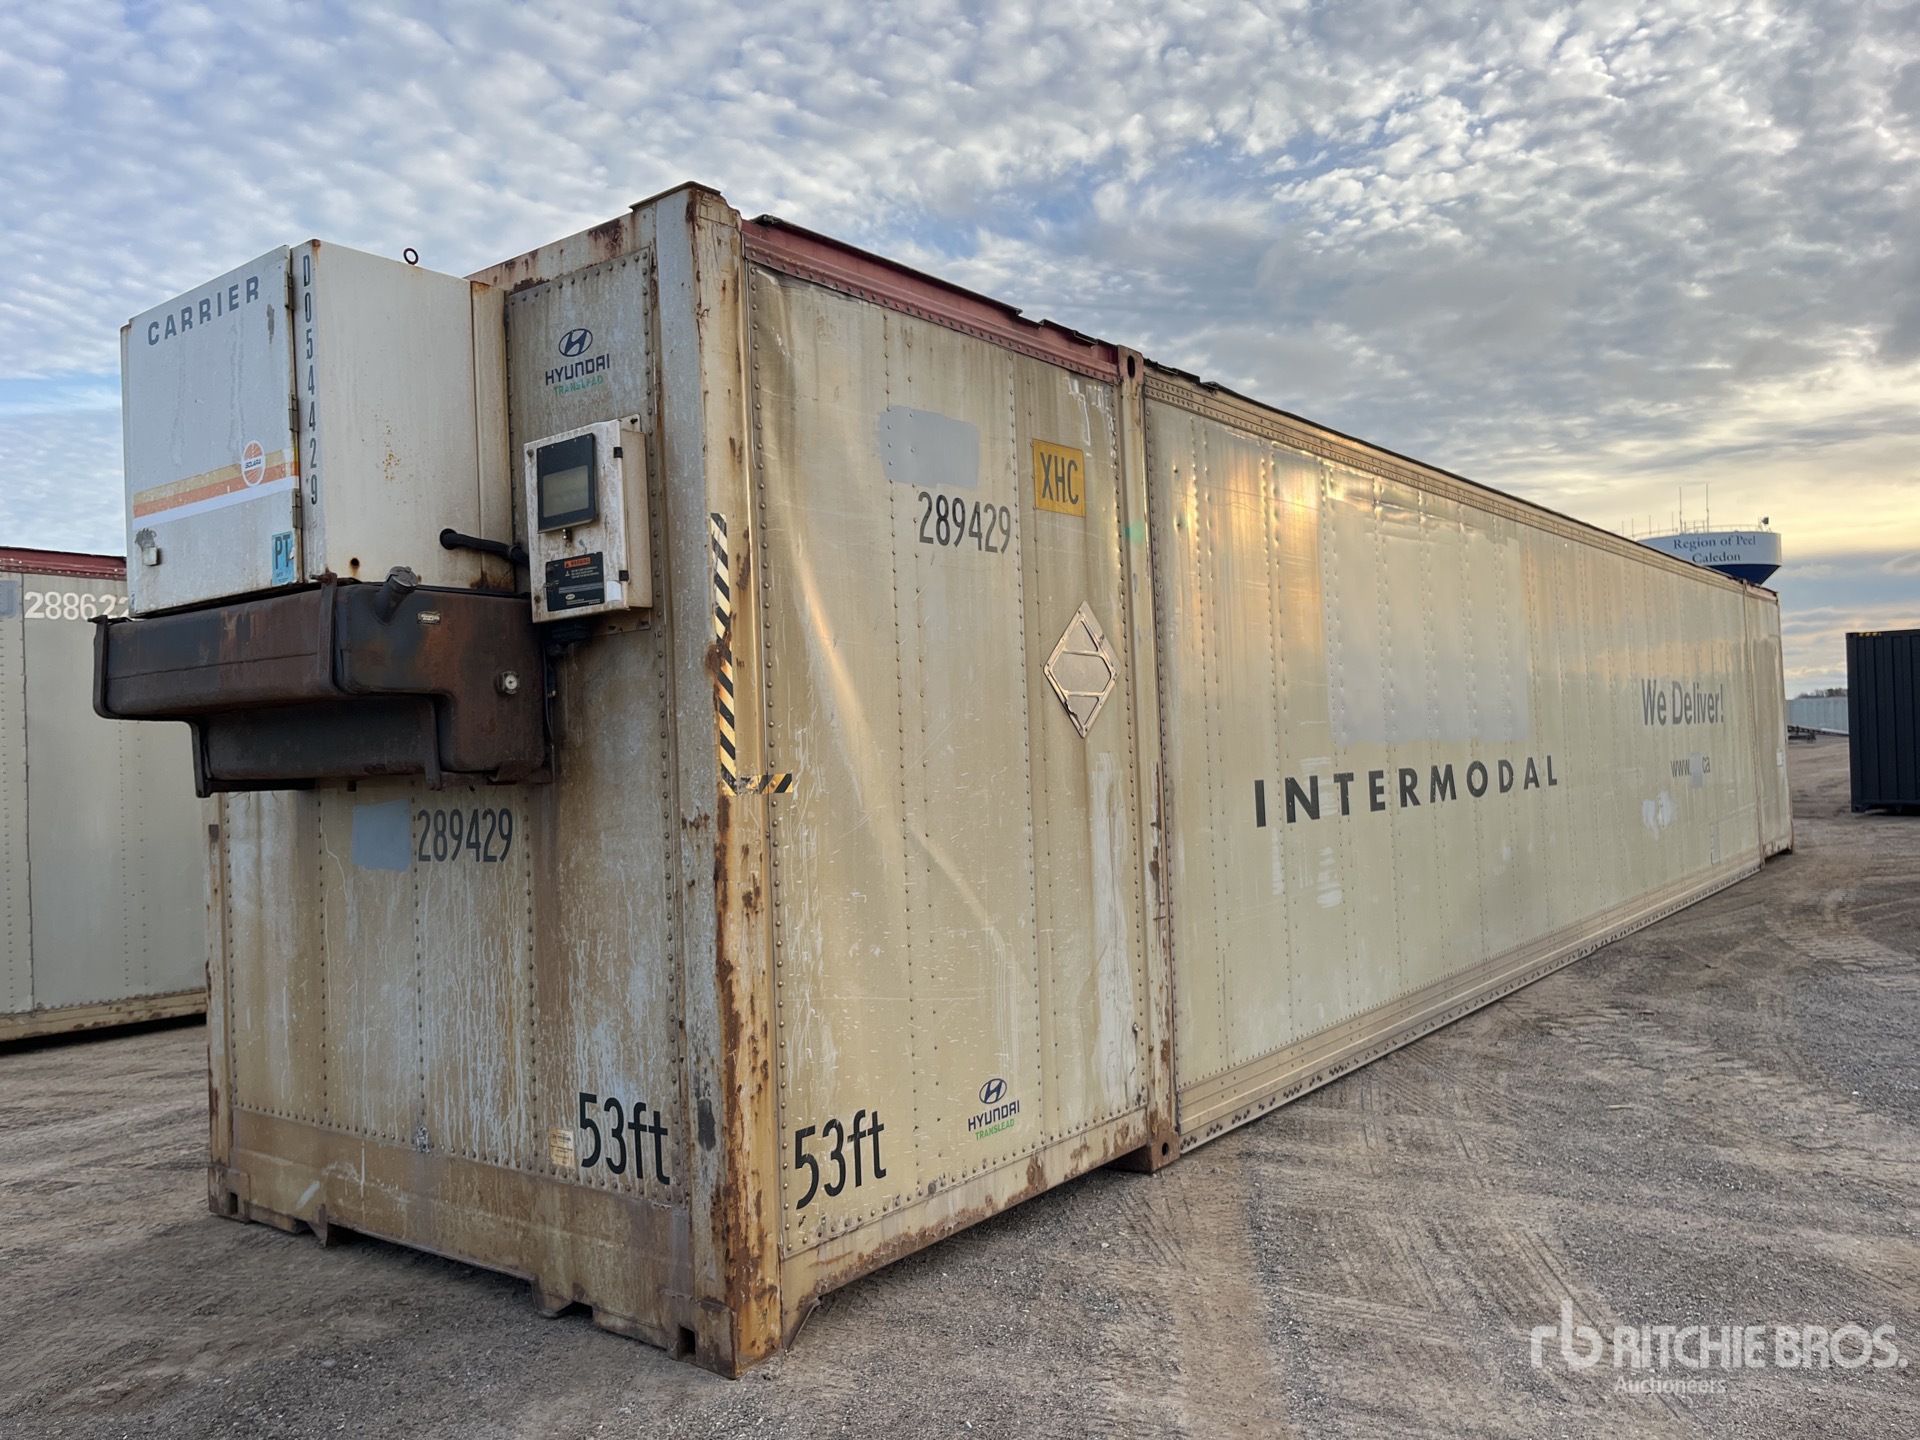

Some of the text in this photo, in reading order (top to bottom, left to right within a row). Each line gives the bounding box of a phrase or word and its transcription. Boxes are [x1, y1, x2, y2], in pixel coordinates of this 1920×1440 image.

[147, 275, 260, 346] CARRIER
[545, 353, 611, 386] HYUNDAI
[1040, 451, 1079, 505] XHC
[917, 490, 1012, 555] 289429
[1673, 534, 1757, 552] Region of Peel
[274, 534, 291, 570] PT
[1692, 552, 1741, 564] Caledon
[1641, 678, 1725, 726] We Deliver!
[1254, 755, 1558, 828] INTERMODAL
[417, 807, 513, 862] 289429
[579, 1091, 670, 1186] 53ft
[967, 1100, 1021, 1132] HYUNDAI
[975, 1118, 1016, 1141] TRANSLEAD
[795, 1108, 887, 1210] 53ft
